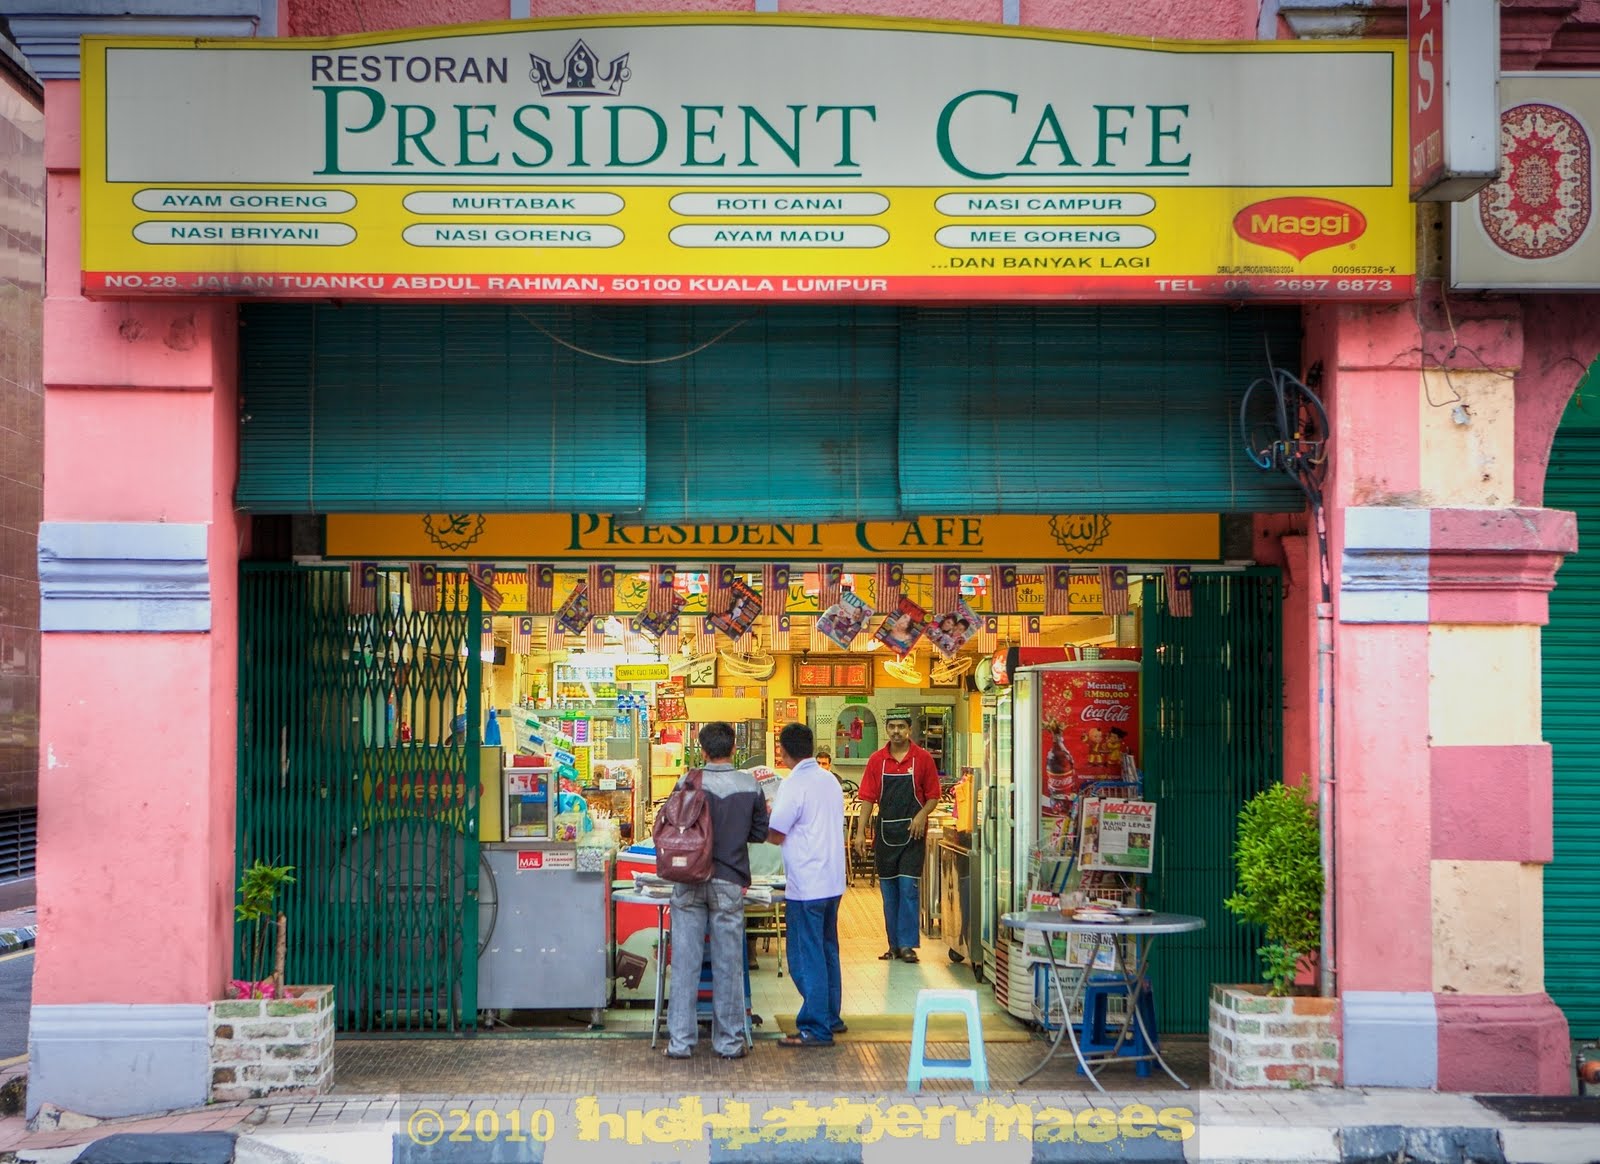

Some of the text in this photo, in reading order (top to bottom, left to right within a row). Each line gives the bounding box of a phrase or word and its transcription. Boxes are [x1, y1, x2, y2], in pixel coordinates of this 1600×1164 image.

[312, 55, 509, 85] RESTORAN
[312, 85, 1192, 180] PRESIDENT CAFE
[162, 194, 328, 209] AYAM GORENG
[452, 196, 576, 210] MURTABAK
[717, 197, 843, 210] ROTI CANAI
[968, 198, 1123, 211] NASI CAMPUR
[1250, 213, 1350, 236] Maggi
[171, 226, 320, 240] NASI BRIYANI
[435, 228, 592, 242] NASI GORENG
[714, 229, 845, 243] AYAM MADU
[970, 230, 1121, 243] MEE GORENG
[1002, 256, 1092, 269] BANYAK
[1099, 256, 1151, 269] LAGI
[191, 275, 273, 289] JALAN
[279, 276, 385, 290] TUANKU
[394, 277, 480, 291] ABDUL
[488, 277, 605, 293] RAHMAN,
[611, 278, 682, 292] 50100
[689, 278, 775, 292] KUALA
[782, 278, 888, 292] LUMPUR
[1154, 279, 1202, 292] TEL
[1273, 279, 1329, 292] 2697
[1337, 279, 1393, 292] 6873
[855, 517, 984, 552] CAFE
[1087, 681, 1126, 690] Menangi
[1103, 803, 1153, 815] WATAN
